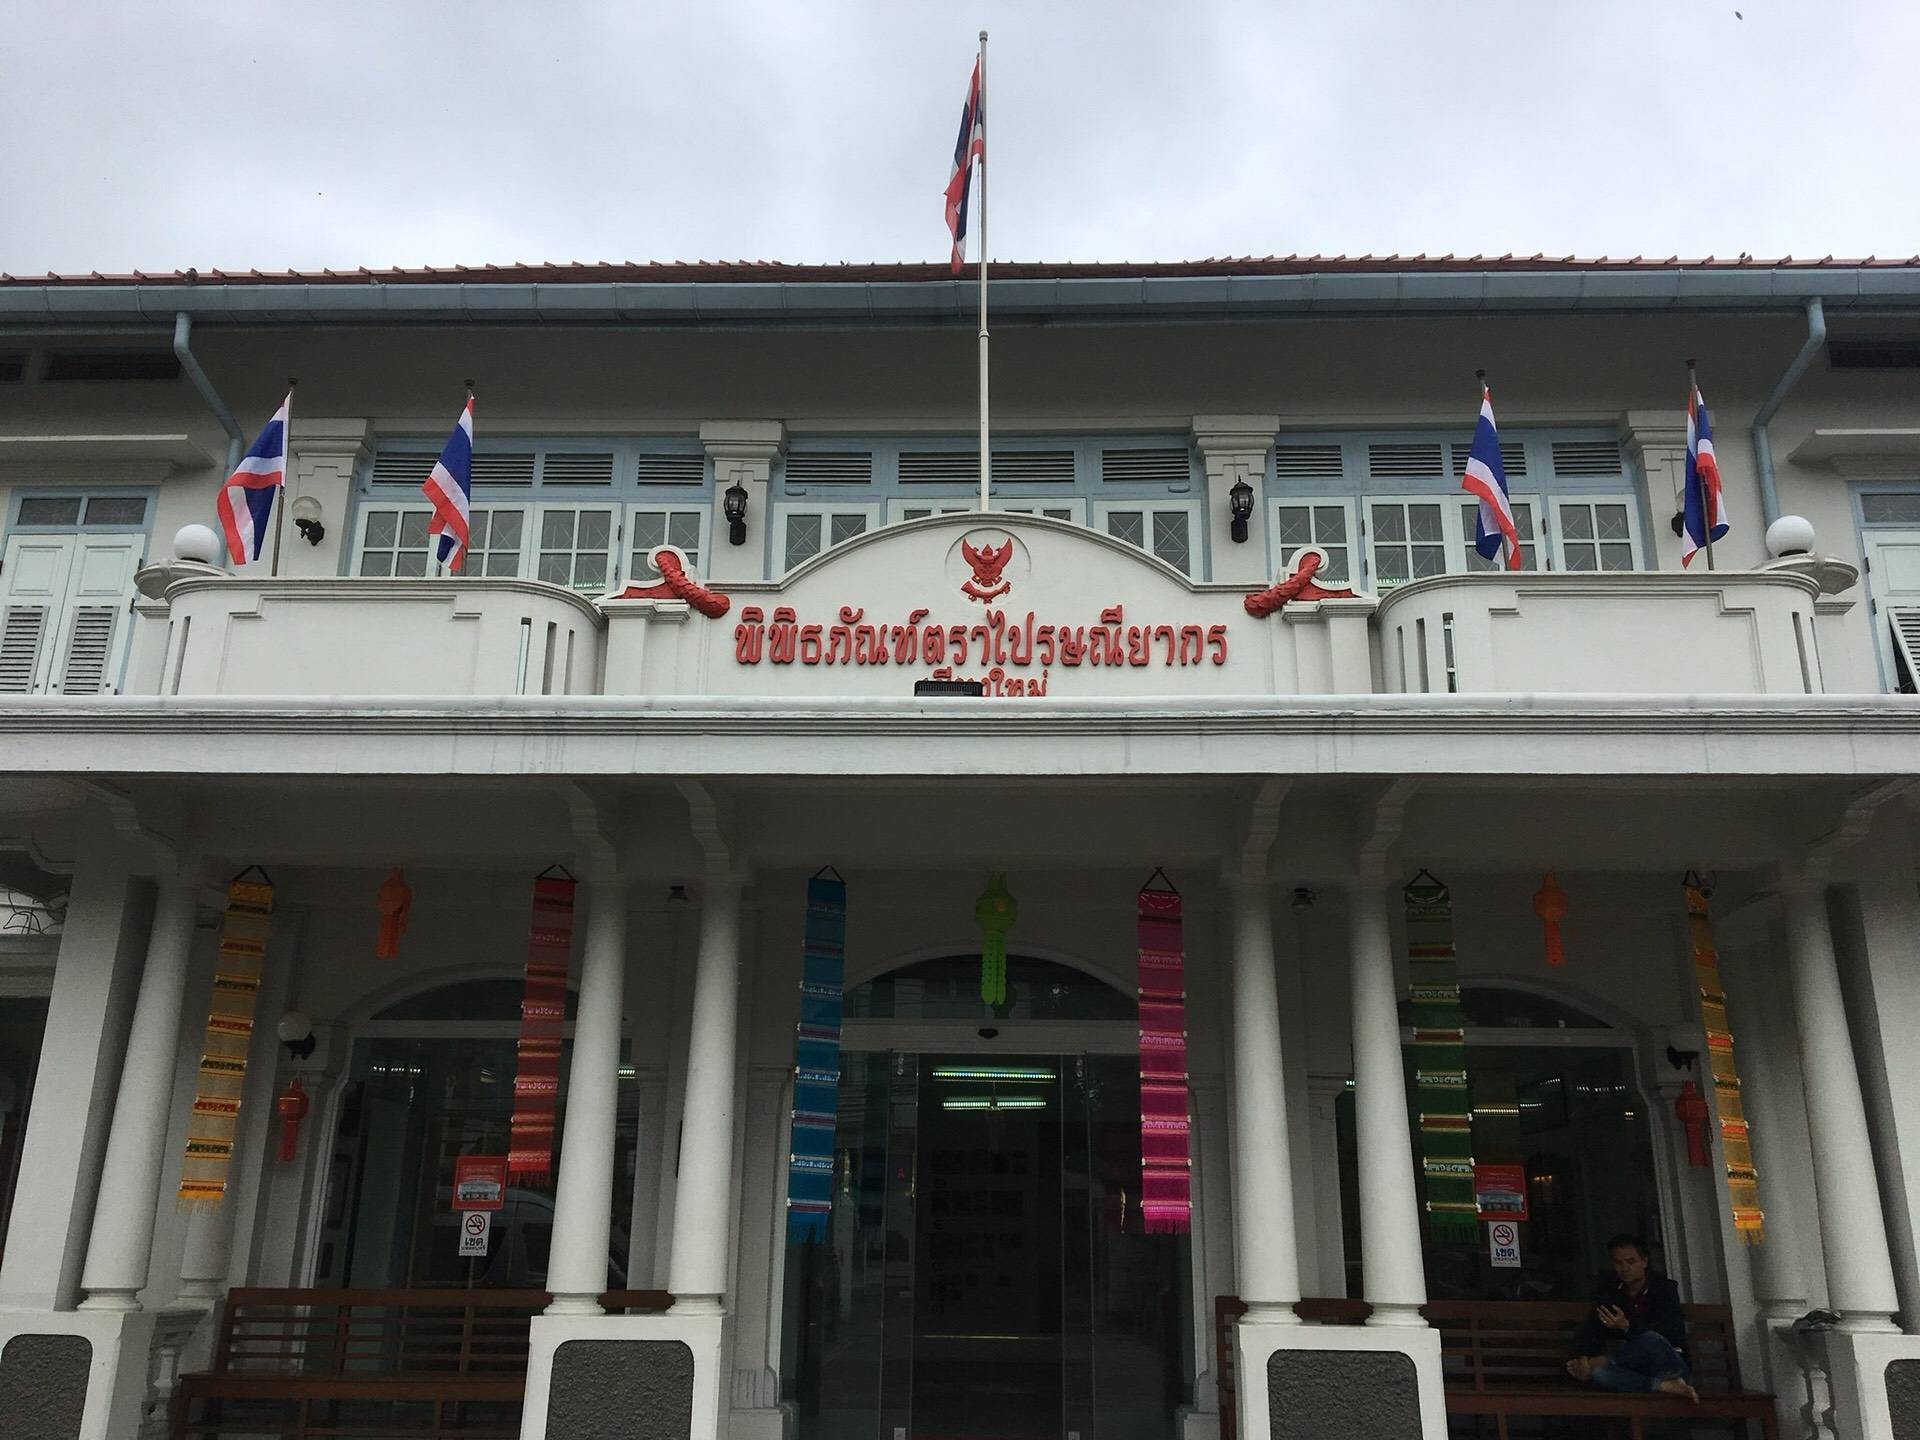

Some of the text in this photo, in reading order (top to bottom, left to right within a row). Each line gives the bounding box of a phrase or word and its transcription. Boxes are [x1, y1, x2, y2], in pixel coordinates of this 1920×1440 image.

[734, 604, 1228, 667] พิพิธภัณฑ์ตราไปรษณียากร
